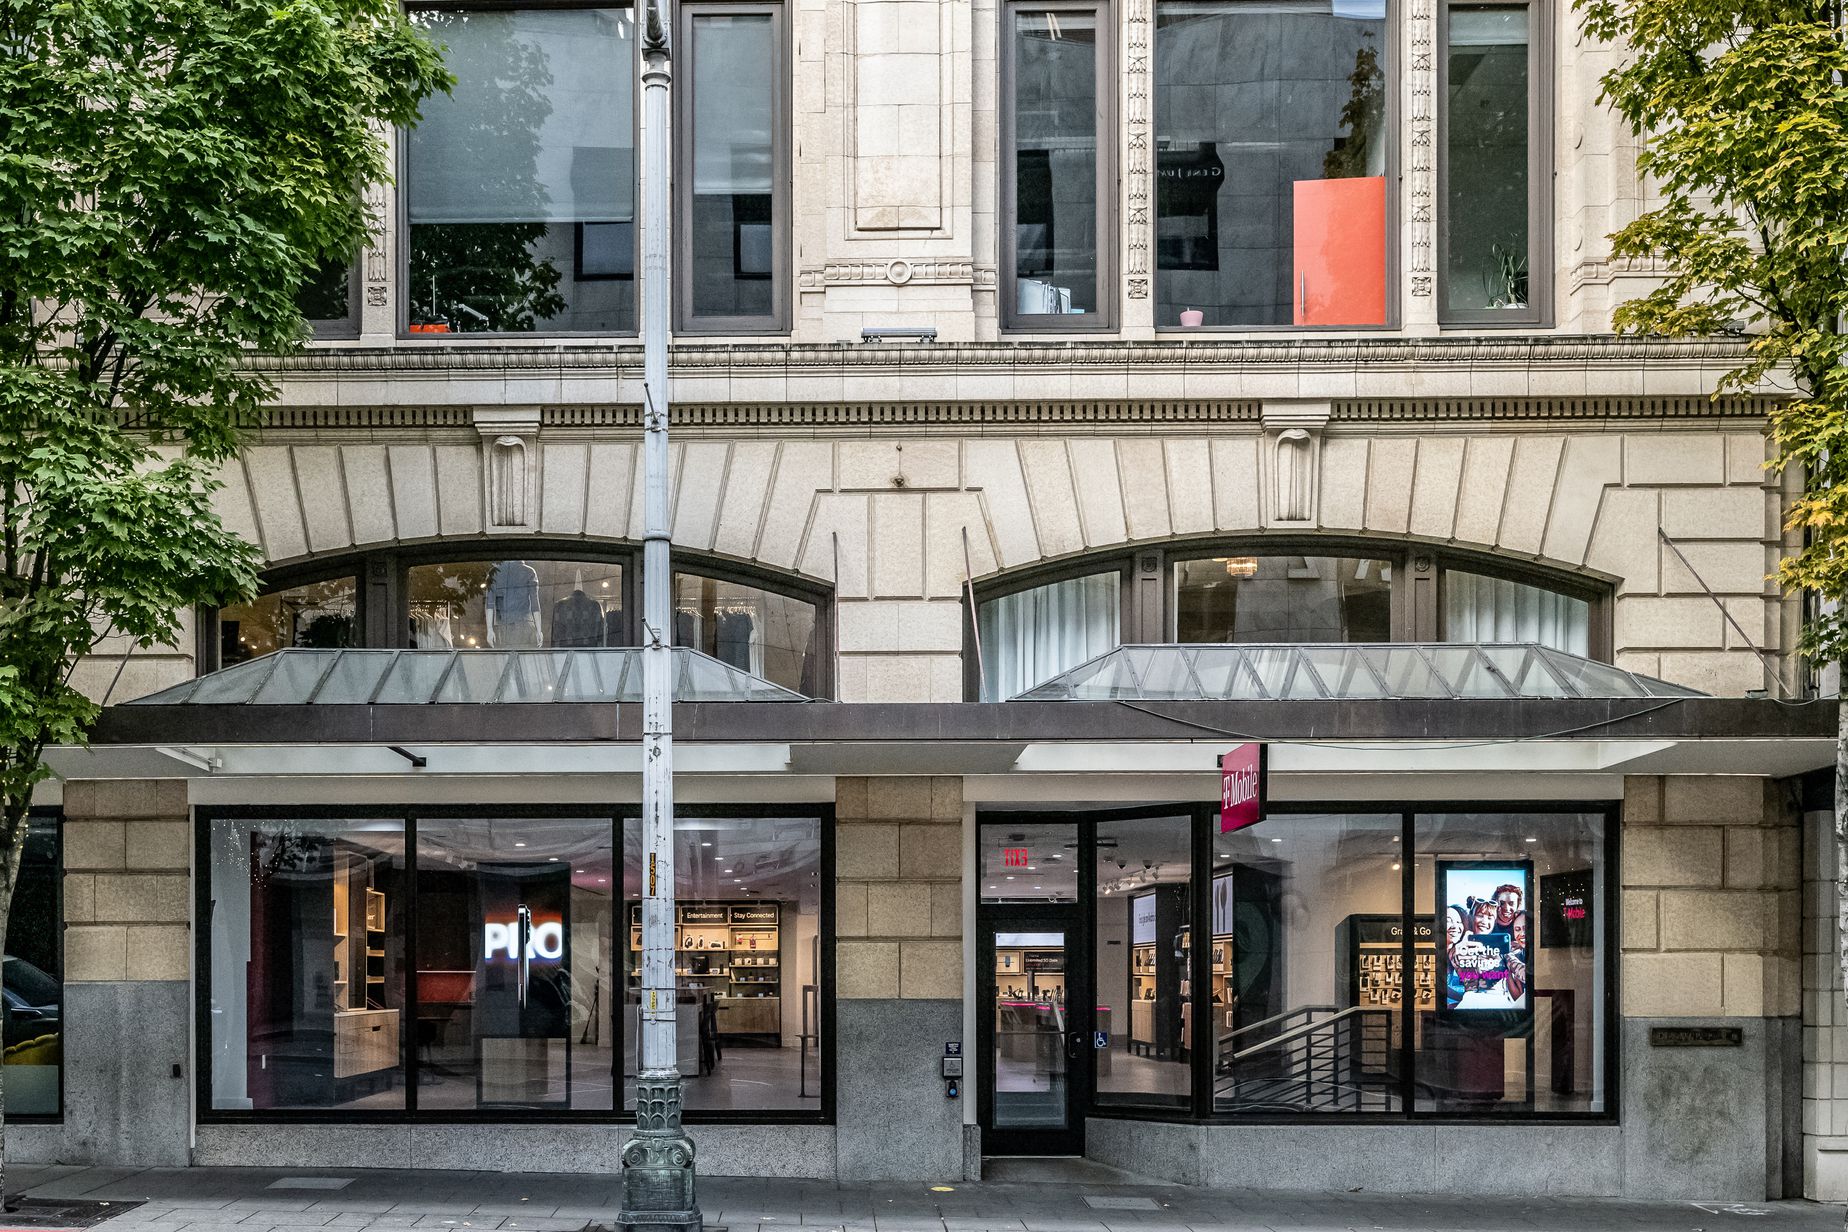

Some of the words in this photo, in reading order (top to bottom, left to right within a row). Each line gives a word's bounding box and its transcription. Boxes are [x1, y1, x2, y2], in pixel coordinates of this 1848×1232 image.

[734, 912, 745, 920] Stay
[1419, 926, 1432, 936] Go
[485, 922, 562, 959] PRO
[1460, 946, 1480, 956] Get
[1482, 945, 1500, 956] the
[1459, 958, 1500, 970] savings
[1459, 971, 1479, 982] you
[1482, 969, 1509, 980] want
